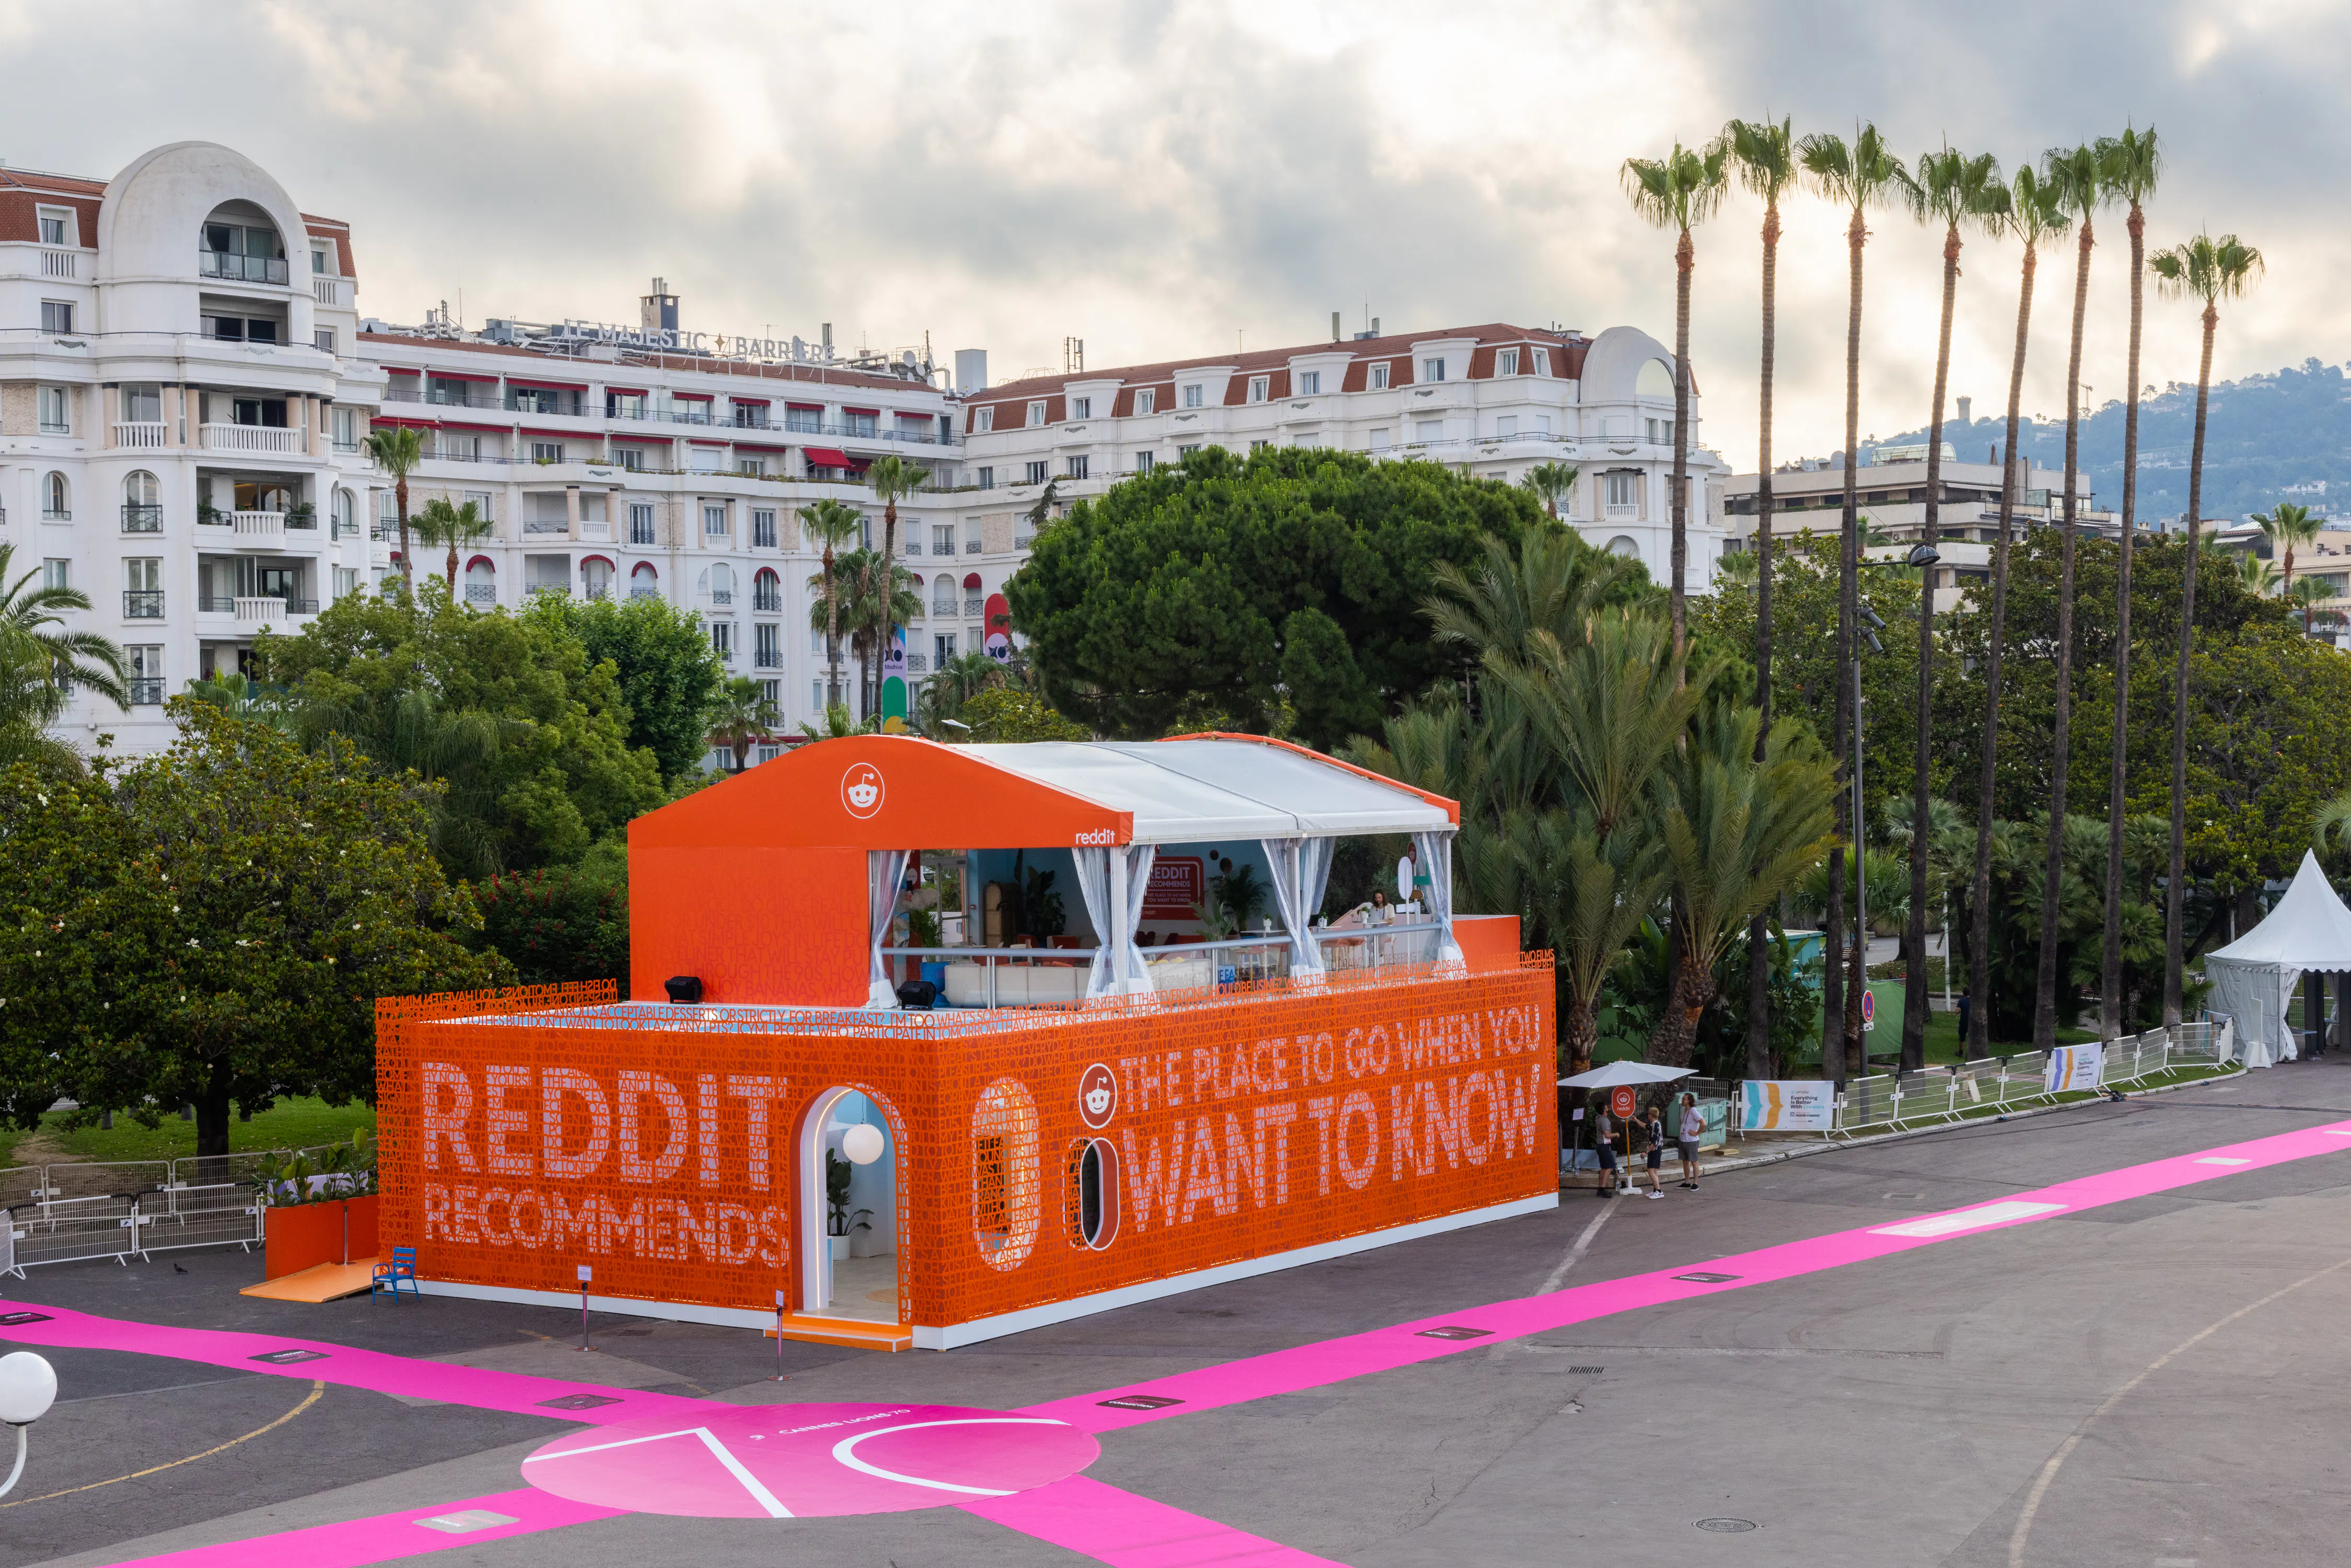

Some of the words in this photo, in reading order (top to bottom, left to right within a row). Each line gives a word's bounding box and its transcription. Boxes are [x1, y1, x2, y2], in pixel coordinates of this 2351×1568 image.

[564, 319, 589, 340] LE
[599, 322, 707, 352] MAJESTIC
[1076, 828, 1115, 844] reddit
[938, 1010, 975, 1027] WHAT'S
[977, 1004, 1034, 1023] SOMETHING
[1037, 1001, 1057, 1016] FREE
[1060, 1000, 1074, 1013] ON
[1075, 997, 1091, 1012] THE
[1093, 993, 1136, 1009] INTERNET
[1137, 990, 1160, 1005] THAT
[1160, 985, 1204, 1002] EVERYONE
[1206, 982, 1241, 997] SHOULD
[1241, 981, 1251, 993] BE
[1253, 977, 1282, 992] USING?
[1285, 974, 1313, 988] WHAT'S
[1358, 967, 1376, 980] WAY
[1412, 961, 1430, 974] HOW
[1520, 950, 1535, 962] TWO
[1537, 948, 1554, 960] FILMS
[567, 1004, 597, 1017] ROLLS
[600, 1005, 664, 1018] ACCEPTABLE
[668, 1007, 717, 1020] DESSERTS
[719, 1008, 737, 1021] OR
[737, 1009, 784, 1022] STRICTLY
[789, 1010, 812, 1023] FOR
[815, 1011, 884, 1025] BREAKFAST?
[907, 1013, 935, 1027] TOO
[1132, 1003, 1161, 1017] WHICH
[566, 1018, 596, 1029] WANT
[678, 1021, 700, 1032] ANY
[774, 1024, 813, 1036] PEOPLE
[818, 1025, 848, 1037] WHO
[853, 1026, 919, 1039] PARTICIPATE
[921, 1028, 934, 1040] IN
[1120, 1050, 1184, 1113] THE
[1192, 1037, 1288, 1102] PLACE
[1296, 1032, 1335, 1086] TO
[1345, 1022, 1390, 1079] GO
[1396, 1015, 1481, 1071] WHEN
[1487, 1006, 1540, 1056] YOU
[620, 1079, 645, 1091] AND
[423, 1062, 787, 1192] REDDIT
[1120, 1104, 1298, 1232] WANT
[1308, 1089, 1378, 1197] TO
[1391, 1064, 1540, 1182] KNOW
[424, 1184, 789, 1268] RECOMMENDS
[779, 1422, 843, 1434] CANNES
[843, 1413, 891, 1424] LIONS
